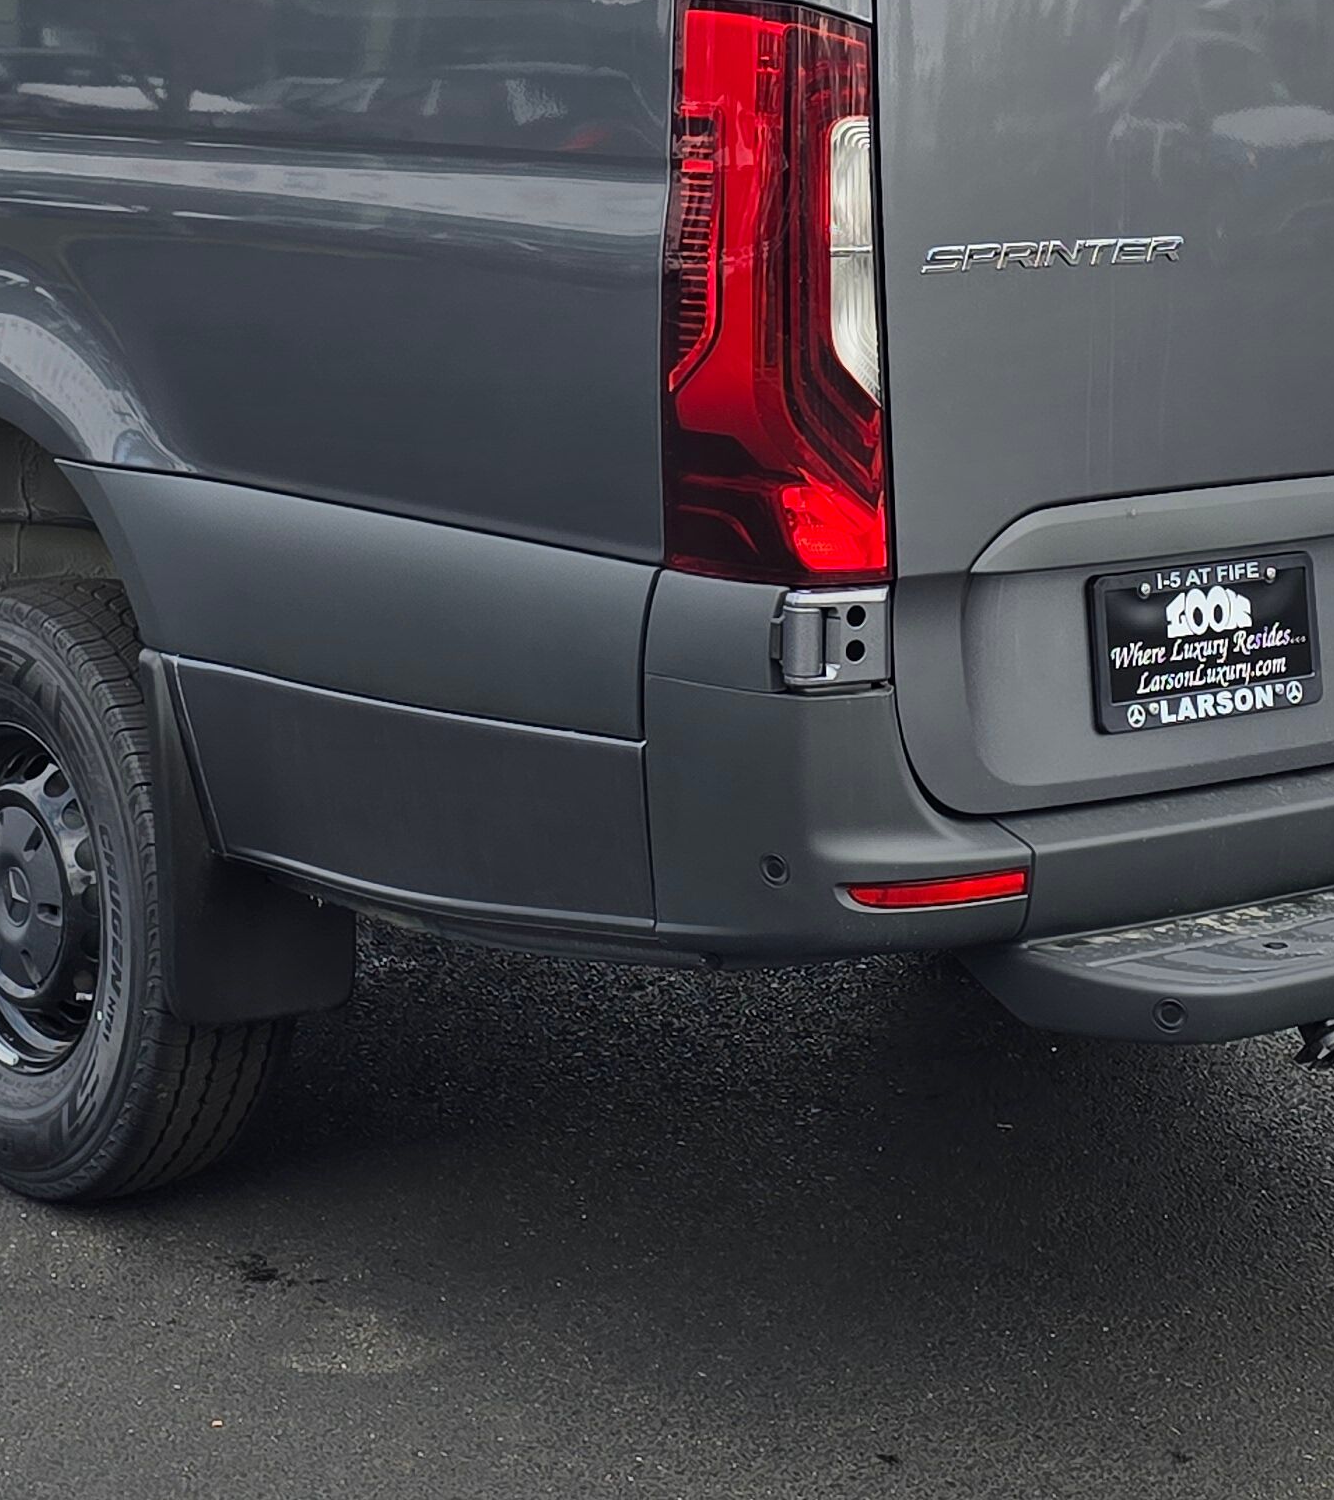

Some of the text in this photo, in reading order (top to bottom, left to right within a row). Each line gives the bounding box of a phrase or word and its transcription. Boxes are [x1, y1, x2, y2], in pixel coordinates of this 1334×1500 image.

[920, 235, 1184, 274] SPRINTER
[1157, 561, 1260, 590] I-5 AT FIFE
[1110, 641, 1166, 669] Where
[1170, 636, 1229, 663] Luxury
[1136, 656, 1287, 694] LarsonLuxury.com
[1160, 684, 1275, 723] LARSON
